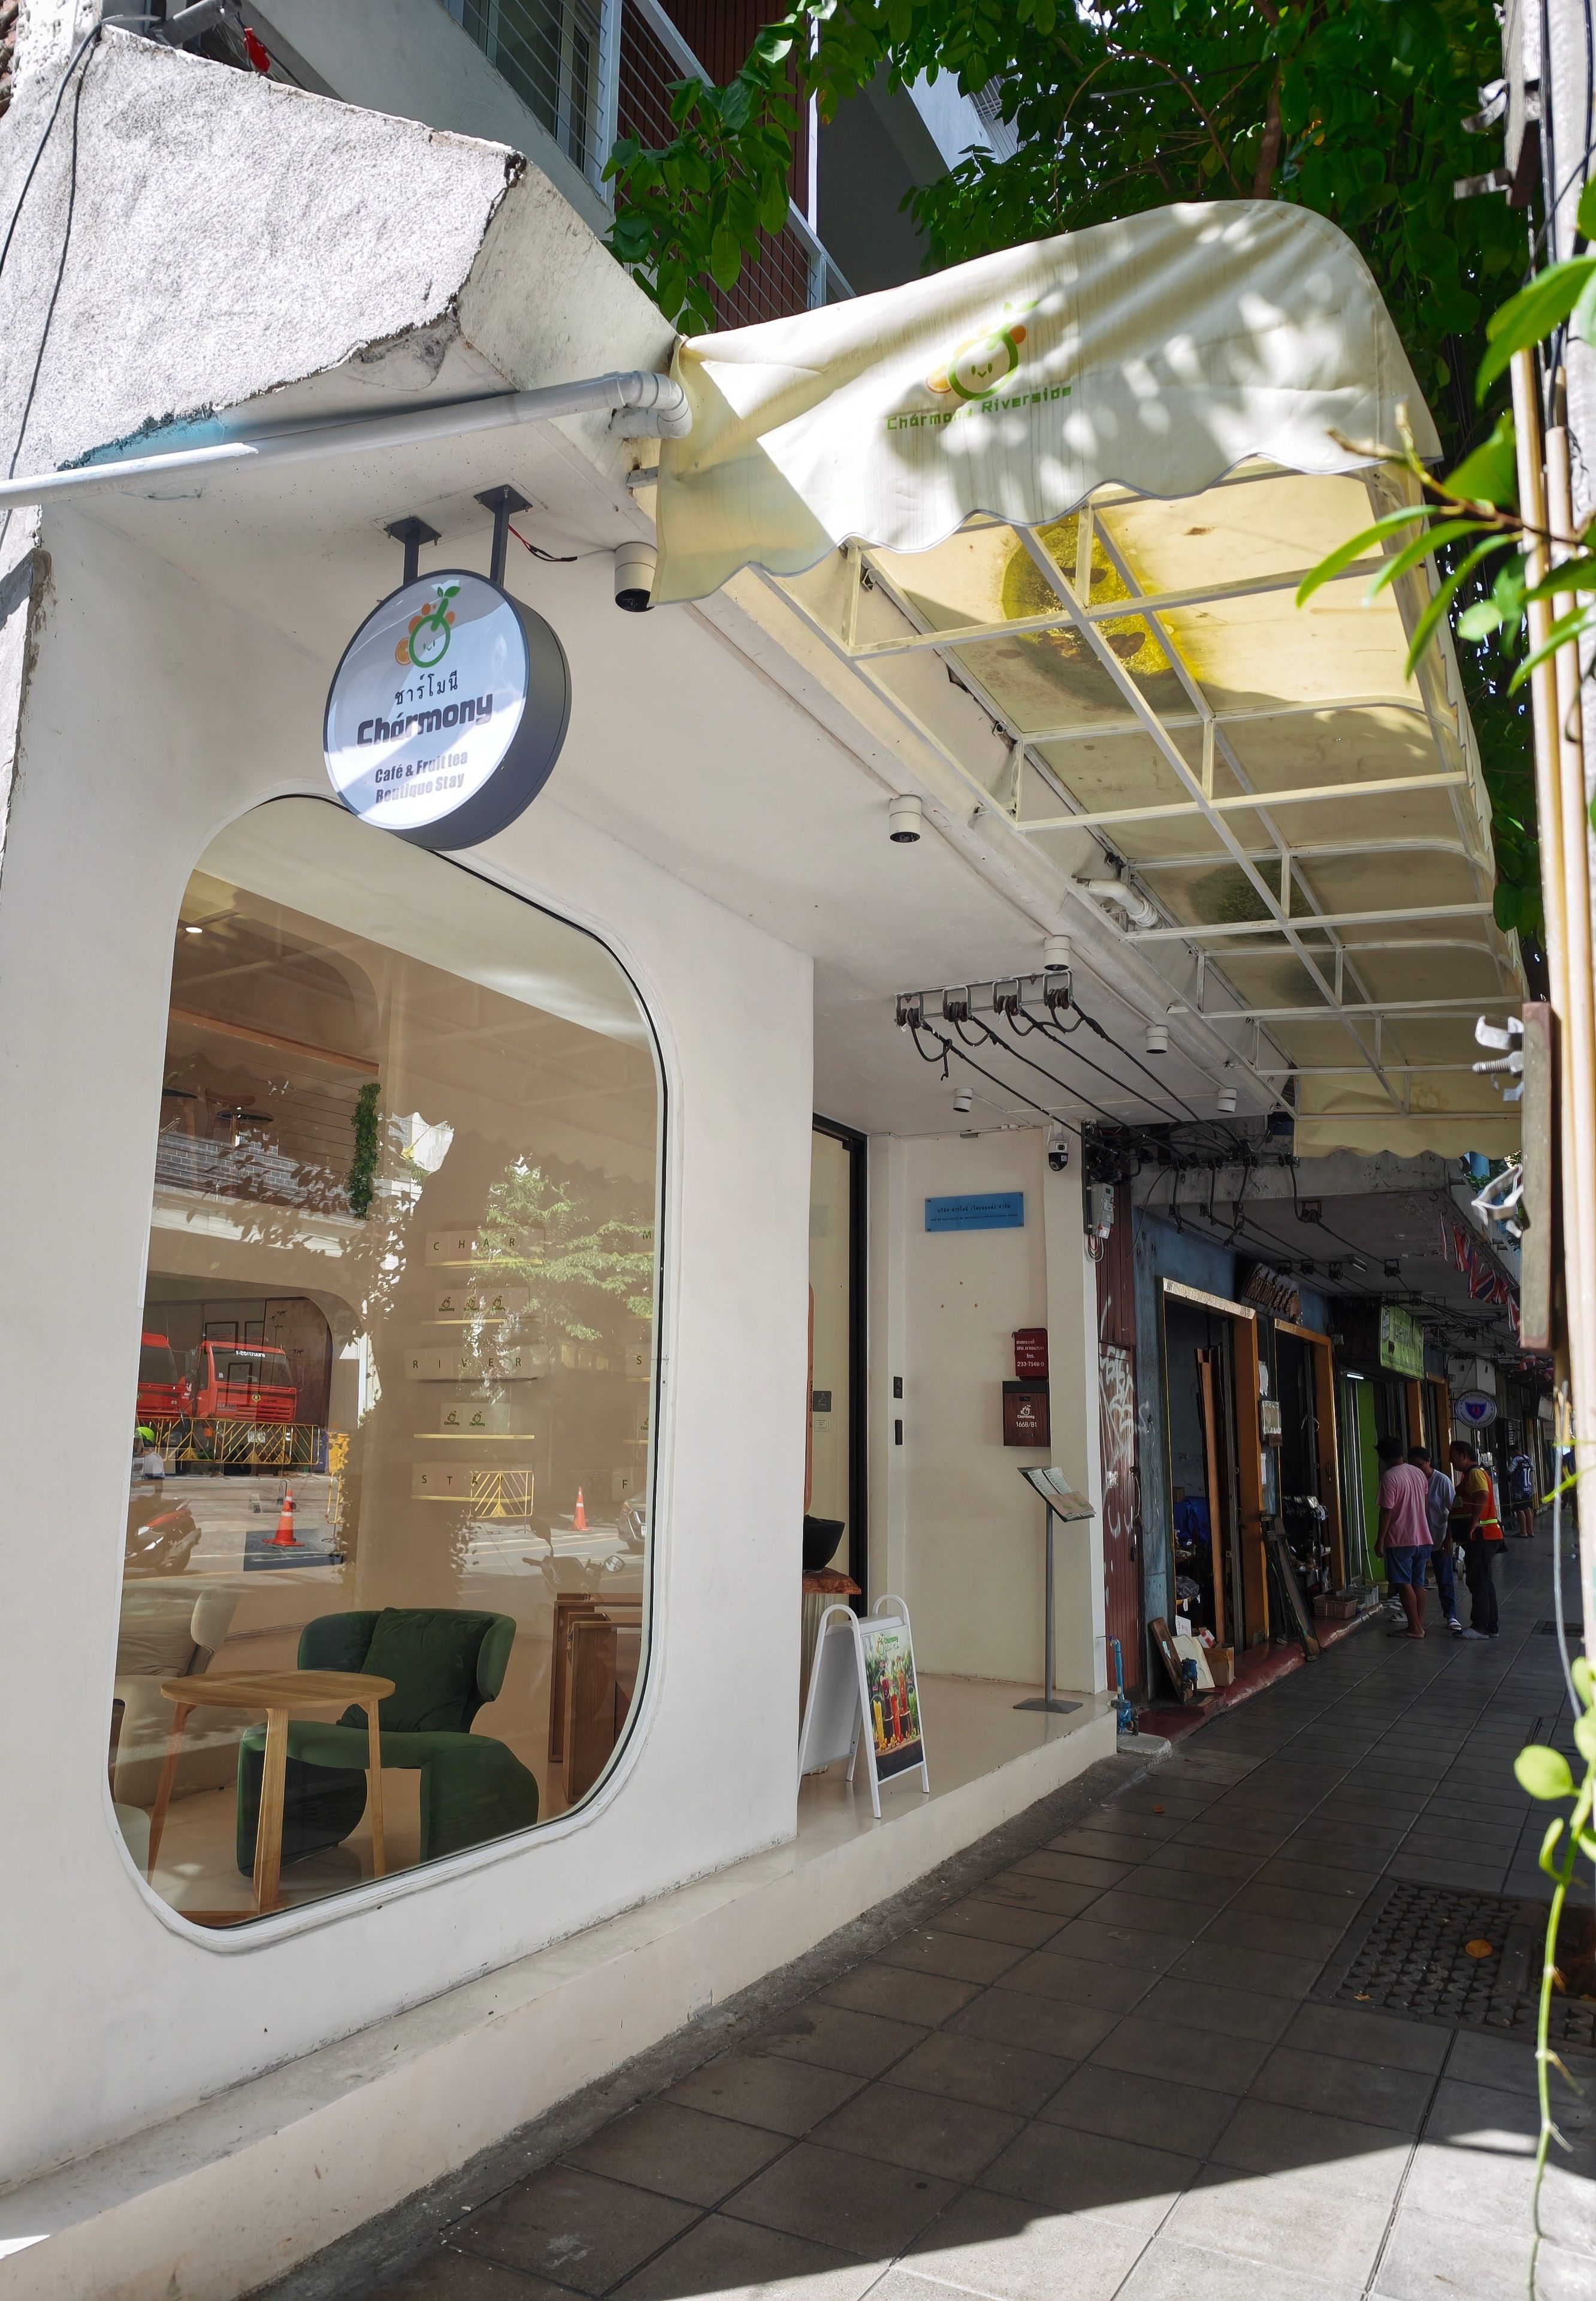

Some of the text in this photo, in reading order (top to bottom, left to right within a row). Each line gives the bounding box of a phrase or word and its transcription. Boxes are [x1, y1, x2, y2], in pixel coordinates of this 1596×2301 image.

[981, 385, 1072, 413] Riverside
[394, 670, 458, 705] ชาร์โมนี
[356, 693, 494, 748] Chármony
[375, 751, 468, 783] Café & Fruit tea
[375, 773, 465, 804] Boutique Stay
